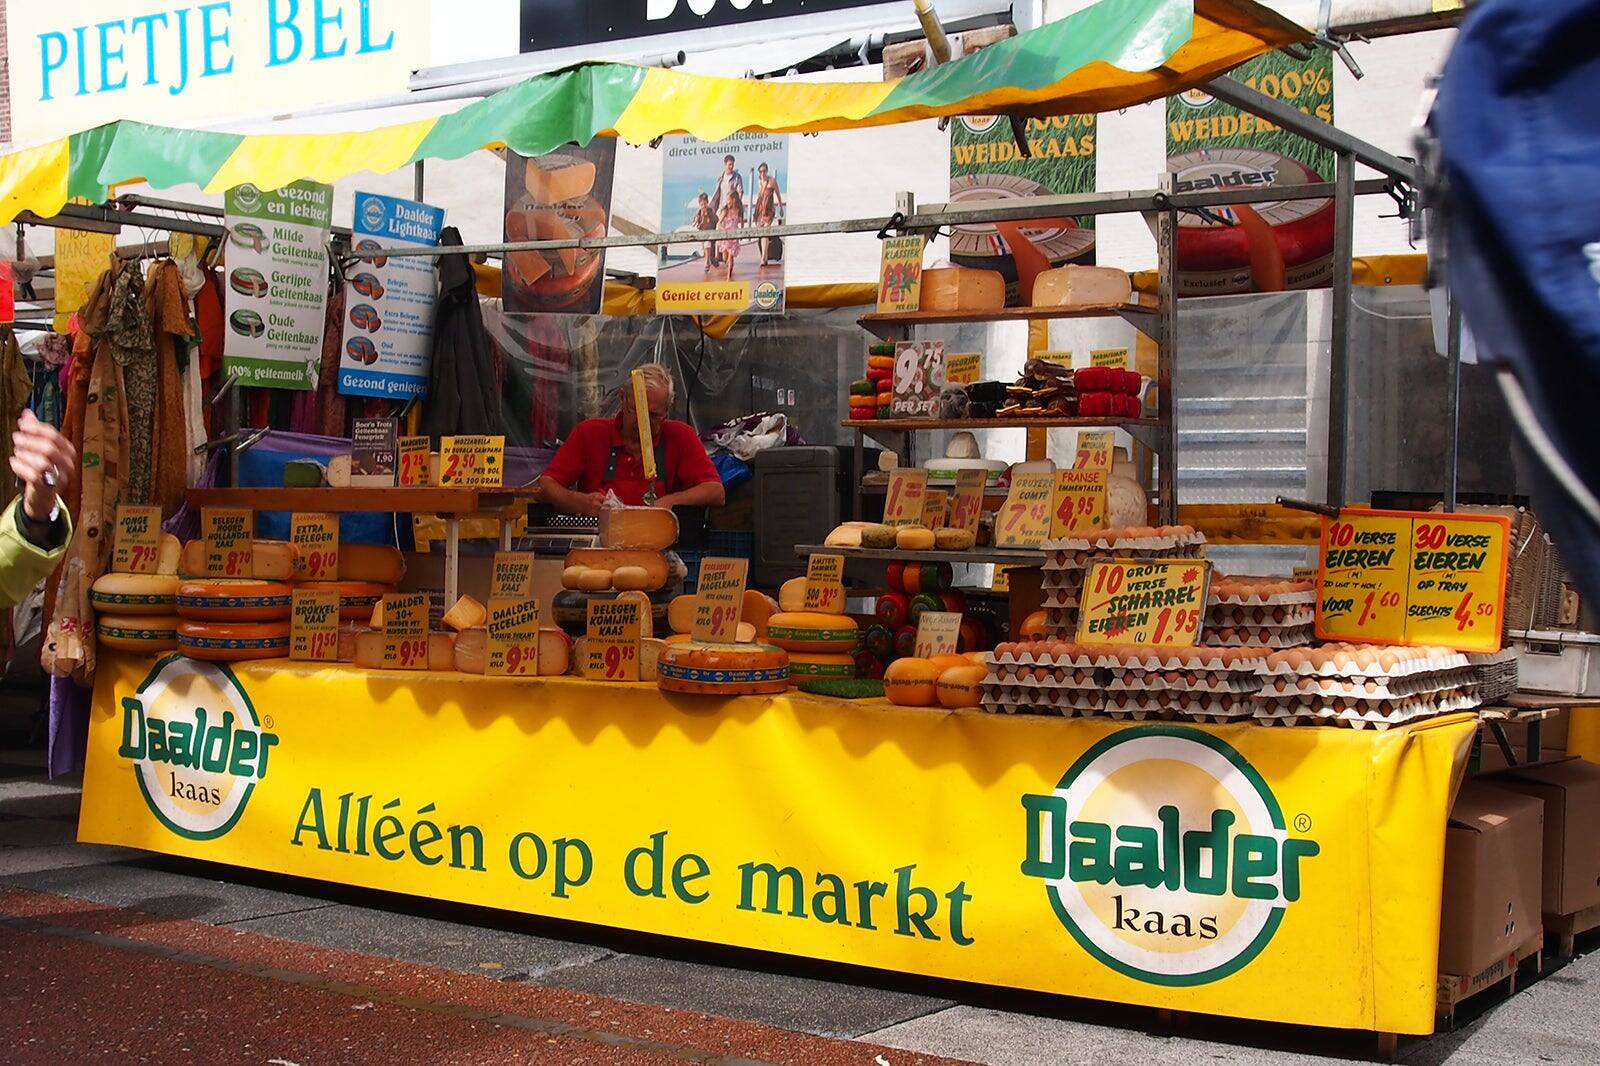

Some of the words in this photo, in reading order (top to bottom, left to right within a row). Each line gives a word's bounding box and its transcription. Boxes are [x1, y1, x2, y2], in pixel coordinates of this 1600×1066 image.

[37, 1, 234, 101] PIETJE
[264, 0, 396, 67] BEL
[1169, 103, 1333, 143] WEIDEKS
[669, 146, 697, 157] direct
[744, 140, 783, 152] verpakt
[1176, 168, 1278, 194] aalder
[277, 188, 325, 205] Gezond
[267, 201, 285, 214] en
[395, 204, 433, 225] Daalder
[273, 227, 304, 242] Milde
[388, 218, 437, 241] Lightkaas
[272, 242, 325, 261] Geitenkaas
[271, 271, 312, 288] Gerijpte
[1183, 278, 1227, 287] Exclusief
[1287, 266, 1326, 285] Exclusief
[270, 286, 323, 303] Geitenkaas
[662, 289, 700, 301] Geniet
[705, 288, 743, 301] ervan!
[268, 313, 296, 328] Oude
[267, 328, 319, 345] Geitenkaas
[254, 367, 304, 381] geitenmelk
[343, 374, 385, 390] Gezond
[895, 401, 915, 413] PER
[917, 401, 934, 412] SET
[377, 454, 393, 463] 1,90
[1062, 472, 1100, 483] FRANSE
[120, 516, 148, 525] JONGE
[212, 516, 245, 525] BELEGEN
[126, 525, 148, 534] KAAS
[296, 524, 324, 534] EXTRA
[1329, 522, 1354, 547] 10
[1354, 531, 1397, 544] VERSE
[1414, 524, 1446, 549] 30
[1446, 533, 1491, 548] VERSE
[215, 540, 234, 548] KAAS
[294, 533, 333, 543] BELEGEN
[1325, 548, 1395, 569] EIEREN
[1414, 551, 1487, 571] EIEREN
[495, 563, 529, 573] BELEGEN
[703, 571, 727, 581] FRIESE
[1094, 565, 1124, 595] 10
[1126, 563, 1169, 578] GROTE
[501, 583, 520, 592] KAAS
[699, 579, 740, 592] NAGELKAAS
[1127, 578, 1167, 592] VERSE
[1417, 580, 1435, 590] OP
[1438, 581, 1468, 592] TRAY
[386, 596, 424, 611] DAALDER
[1107, 585, 1196, 613] SCHARREL
[1322, 596, 1354, 613] VOOR
[396, 609, 413, 620] 30+
[492, 600, 536, 621] DAALDER
[593, 604, 637, 615] BELEGEN
[1408, 604, 1453, 617] SLECHTS
[304, 614, 327, 624] KAAS
[488, 609, 540, 634] EXCELLENT
[696, 618, 711, 626] KILO
[598, 626, 624, 636] KAAS
[491, 651, 503, 659] PER
[489, 660, 504, 668] KILO
[118, 696, 279, 780] Daalder
[169, 770, 221, 806] kaas
[1020, 793, 1321, 902] Daalder
[291, 787, 487, 872] Alléén
[508, 831, 593, 899] op
[624, 830, 711, 903] de
[737, 862, 975, 947] markt
[1111, 894, 1219, 941] kaas
